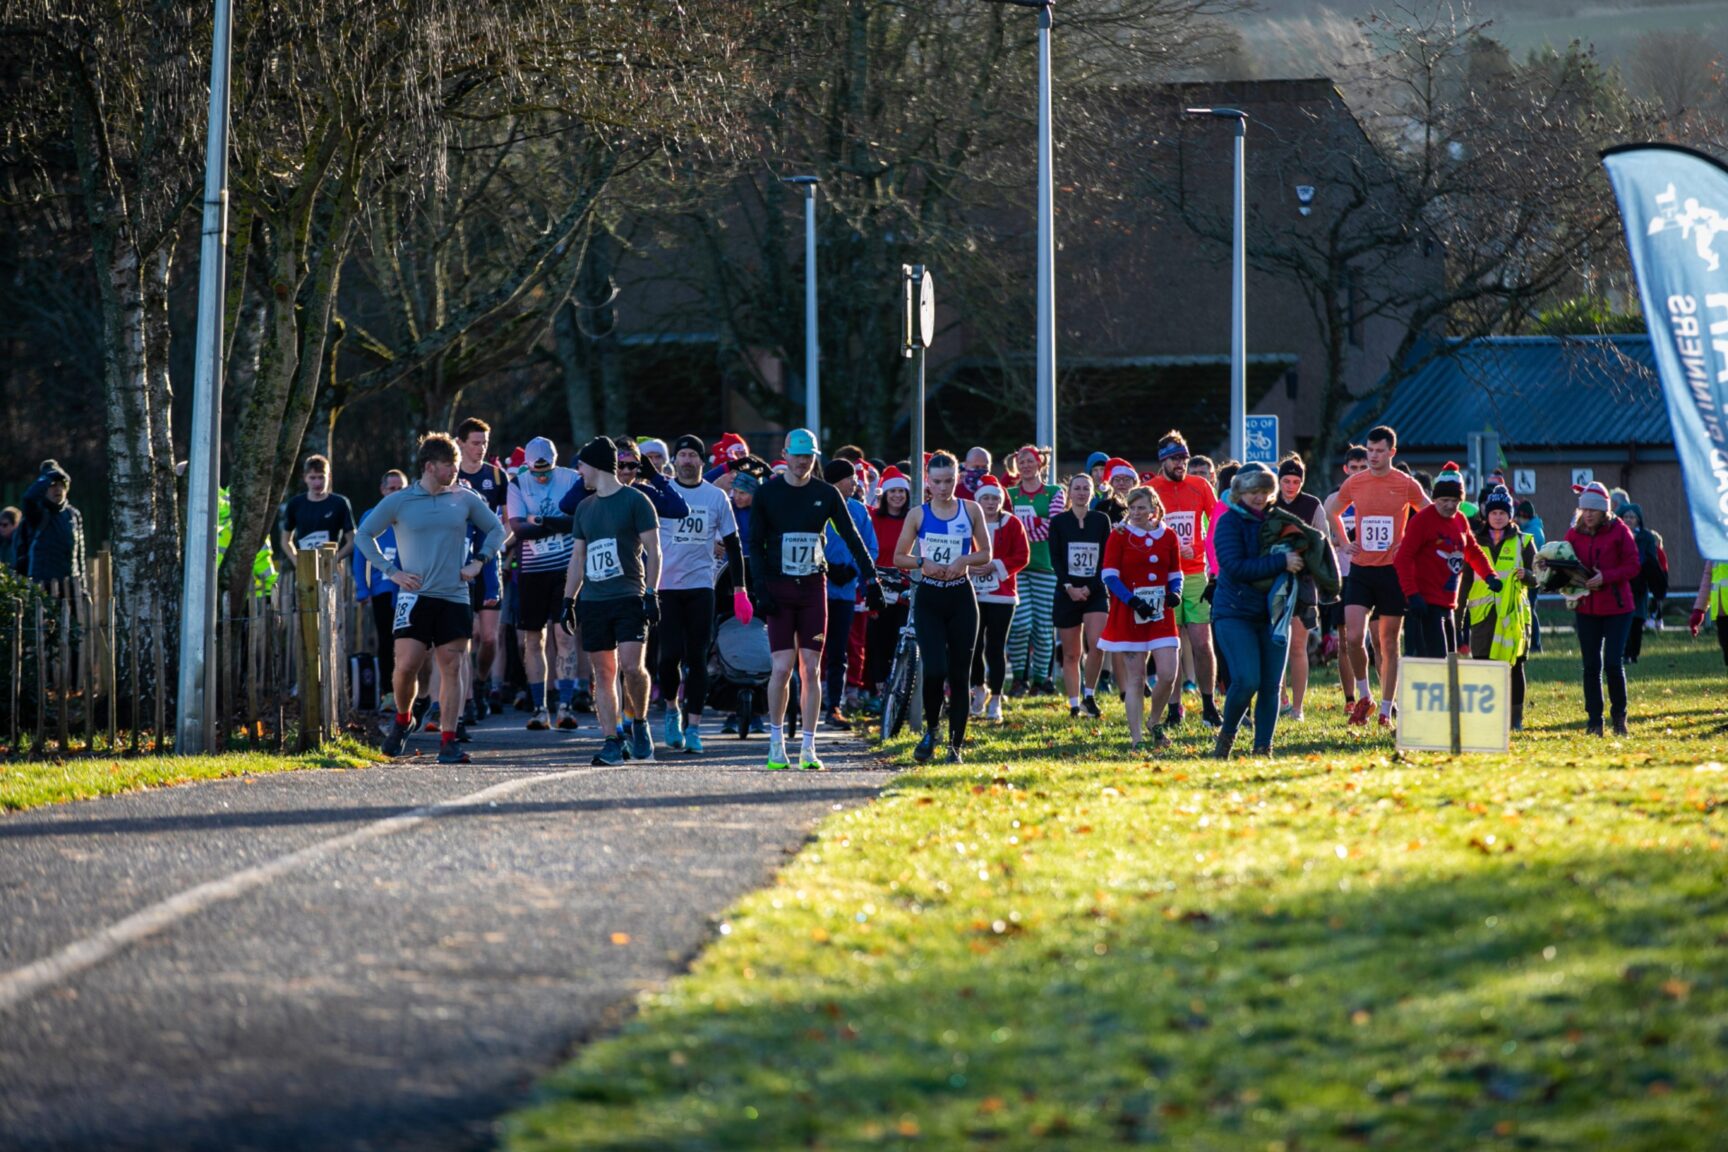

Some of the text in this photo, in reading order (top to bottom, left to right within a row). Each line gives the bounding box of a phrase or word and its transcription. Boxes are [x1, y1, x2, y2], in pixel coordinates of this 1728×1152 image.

[1260, 419, 1273, 428] OF
[1246, 450, 1271, 460] OUTE
[677, 516, 704, 534] 290
[926, 536, 949, 544] FORFAR
[1366, 526, 1389, 541] 313
[591, 550, 614, 571] 178
[792, 545, 815, 563] 171
[933, 547, 951, 563] 64
[1073, 552, 1094, 567] 321
[922, 576, 944, 588] NIKE
[945, 577, 966, 588] PRO
